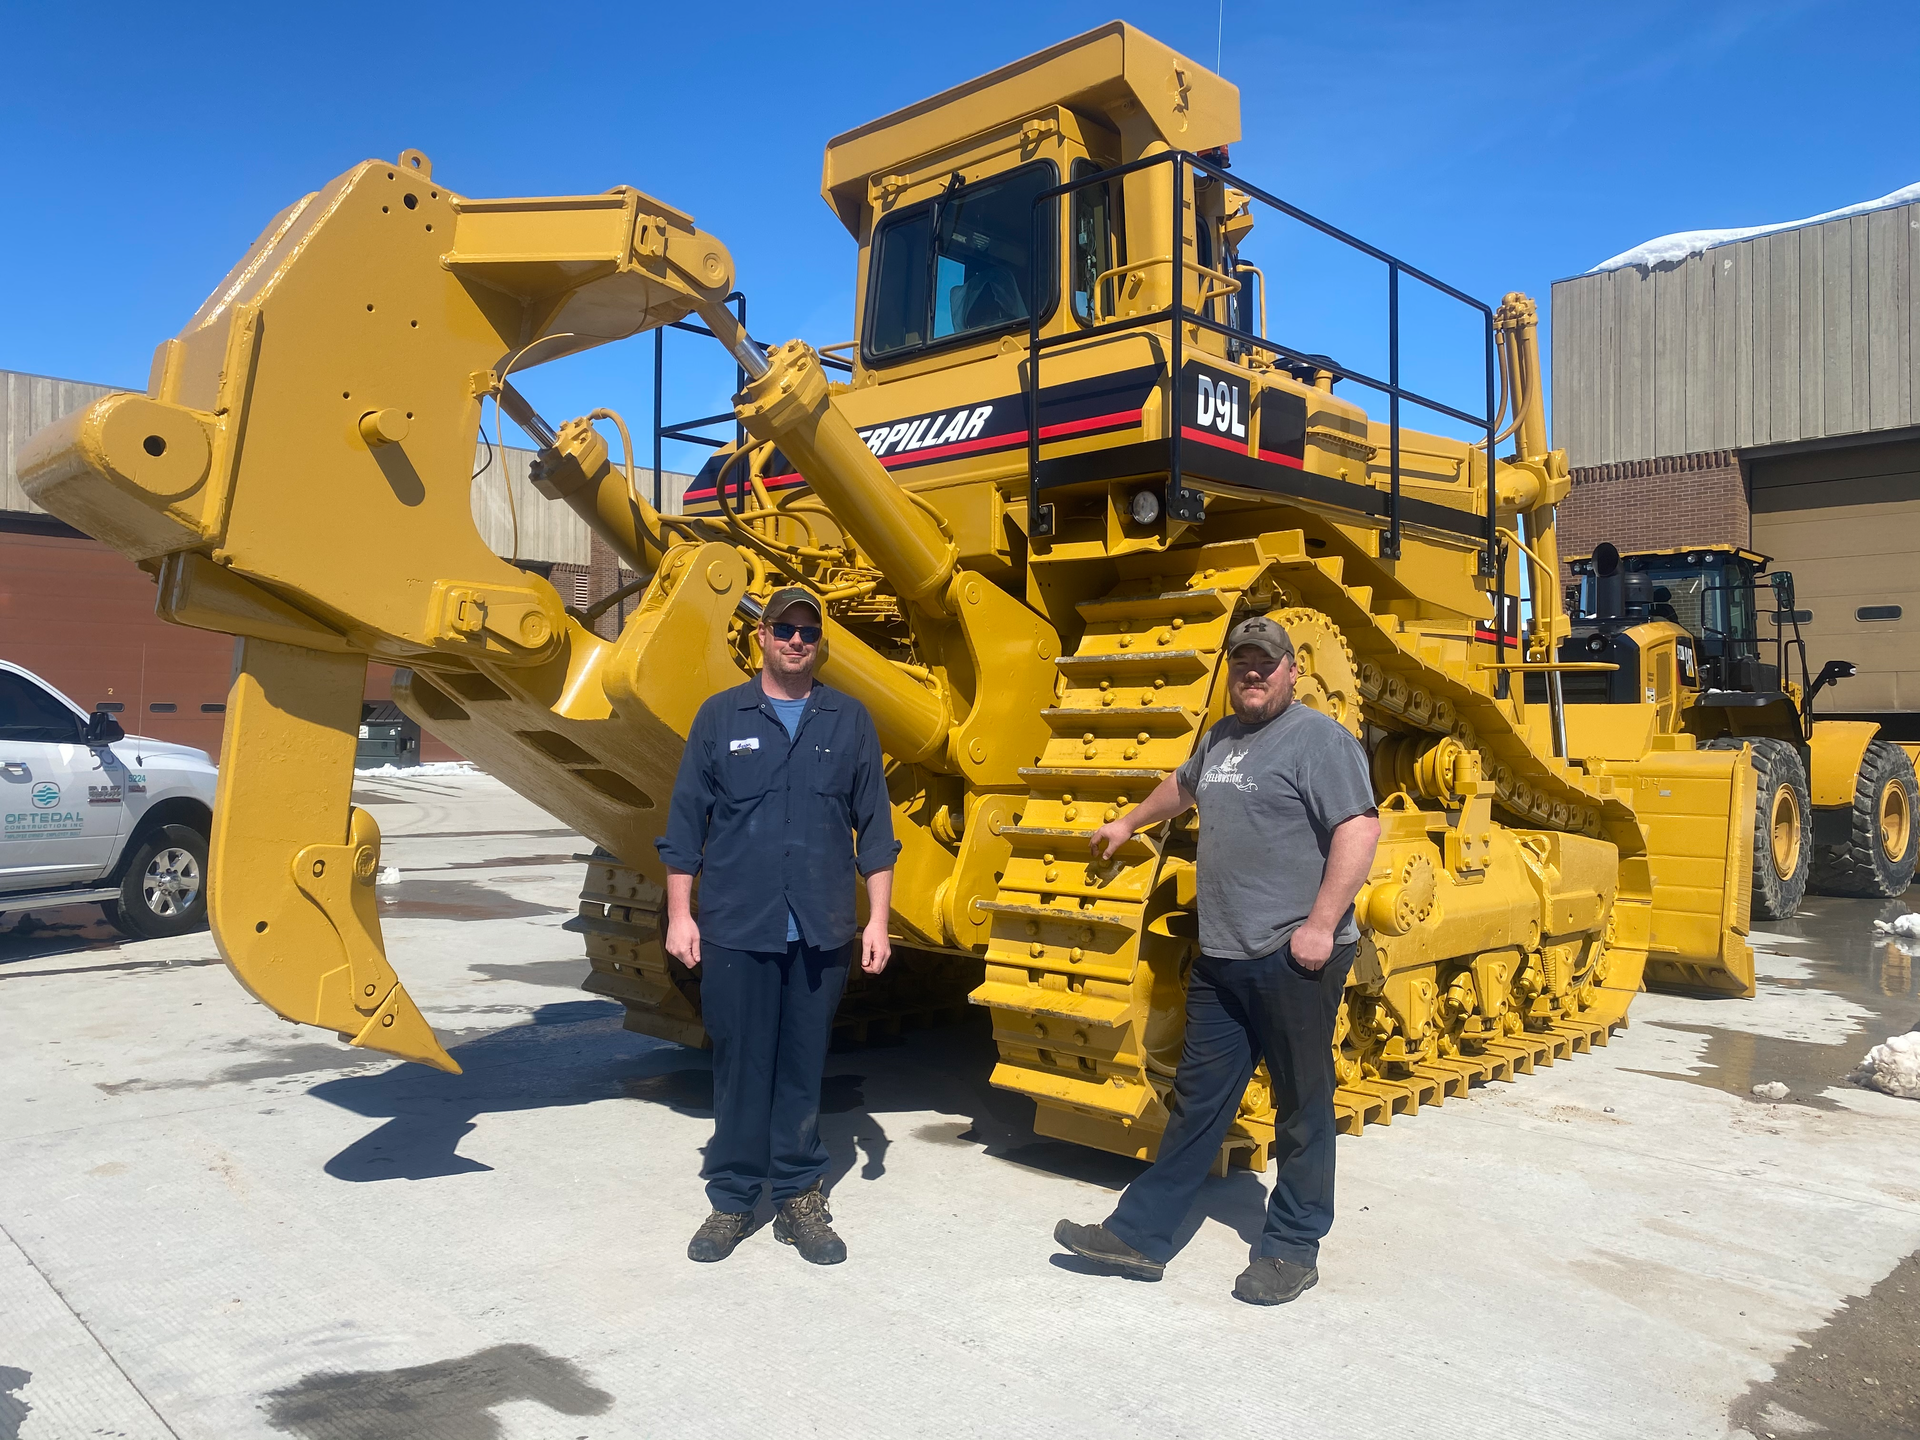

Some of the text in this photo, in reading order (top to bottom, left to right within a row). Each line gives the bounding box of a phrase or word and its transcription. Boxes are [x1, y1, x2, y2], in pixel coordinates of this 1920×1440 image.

[1197, 373, 1245, 438] D9L
[107, 687, 114, 695] 2
[128, 774, 146, 783] 5224
[5, 812, 84, 824] OFTEDAL
